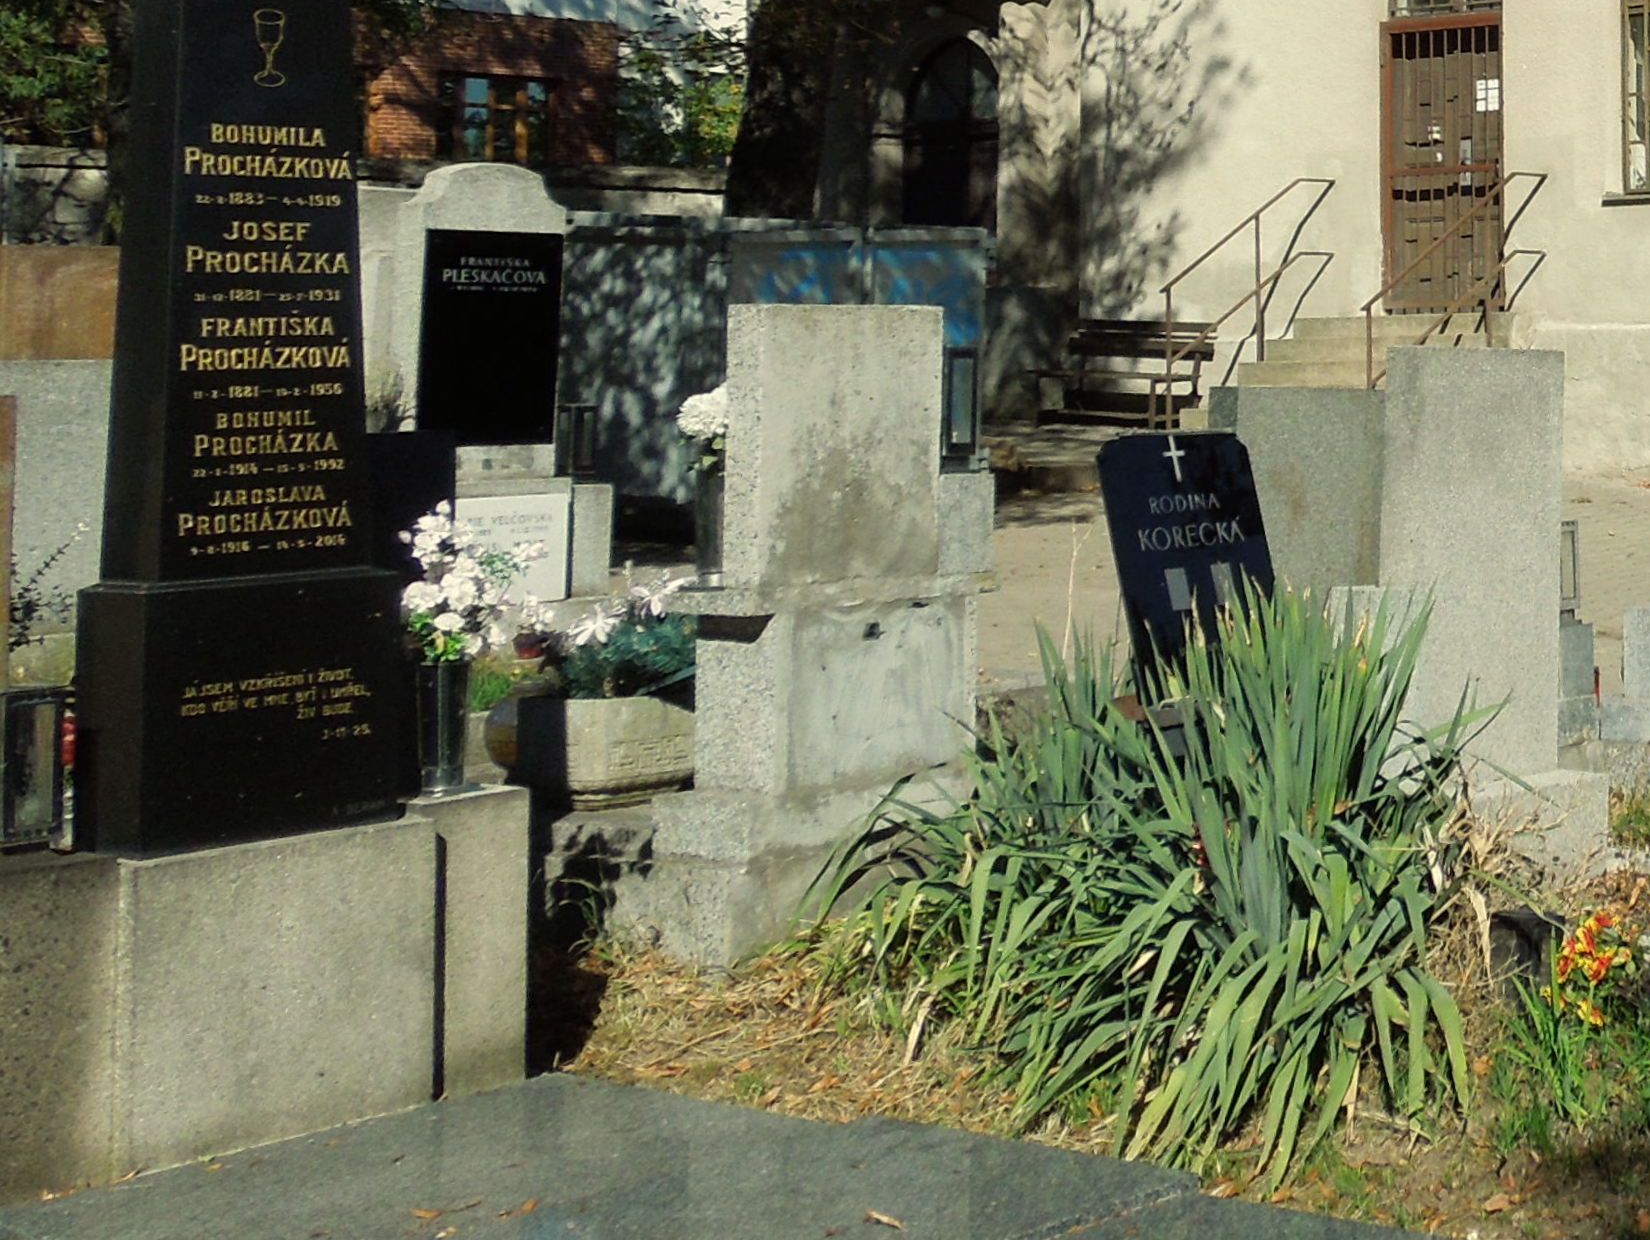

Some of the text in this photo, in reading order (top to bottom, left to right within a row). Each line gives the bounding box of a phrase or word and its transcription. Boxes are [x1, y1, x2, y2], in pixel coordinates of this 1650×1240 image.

[211, 123, 326, 147] BOHUMILA
[184, 147, 352, 180] PROCHÁZKOVÁ
[222, 221, 311, 241] JOSEF
[185, 244, 349, 274] PROCHÁZKA
[201, 310, 334, 337] FRANTIŠKA
[180, 337, 350, 371] PROCHÁZKOVÁ
[216, 409, 316, 430] BOHUMIL
[194, 429, 338, 457] PROCHÁZKA
[209, 485, 326, 507] JAROSLAVA
[1149, 492, 1222, 515] RODINA
[178, 500, 352, 536] PROCHÁZKOVÁ
[1138, 516, 1245, 551] KORECKÁ
